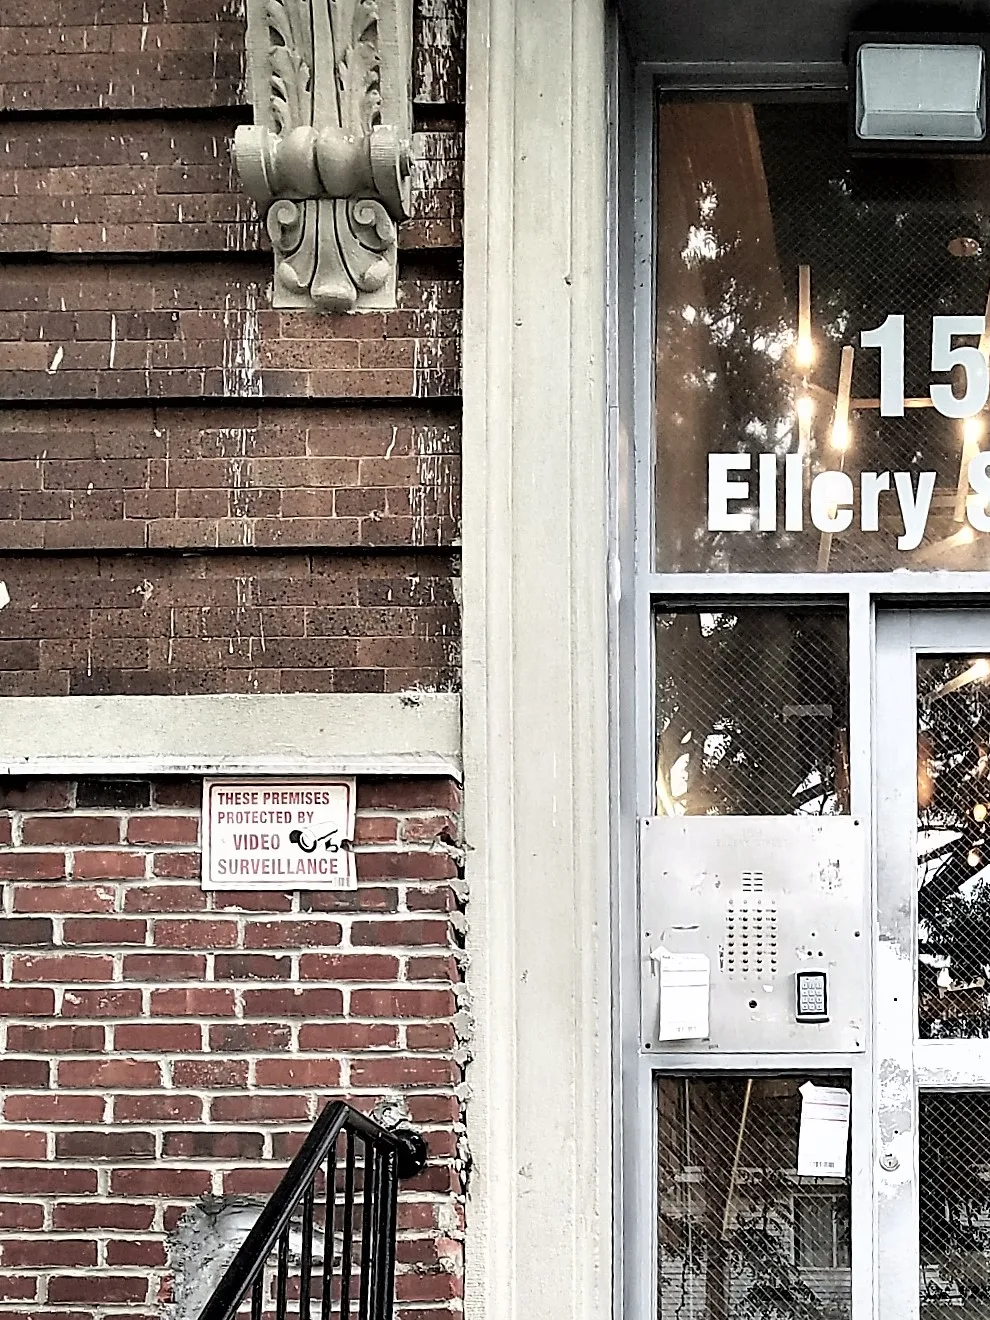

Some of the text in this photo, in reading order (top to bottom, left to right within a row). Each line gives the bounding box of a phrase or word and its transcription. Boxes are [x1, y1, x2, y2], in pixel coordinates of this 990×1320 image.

[706, 453, 937, 551] Ellery
[217, 792, 330, 805] THESE PREMISES
[217, 811, 314, 824] PROTECTED BY
[233, 834, 280, 850] VIDEO
[217, 858, 338, 875] SURVEILLANCE
